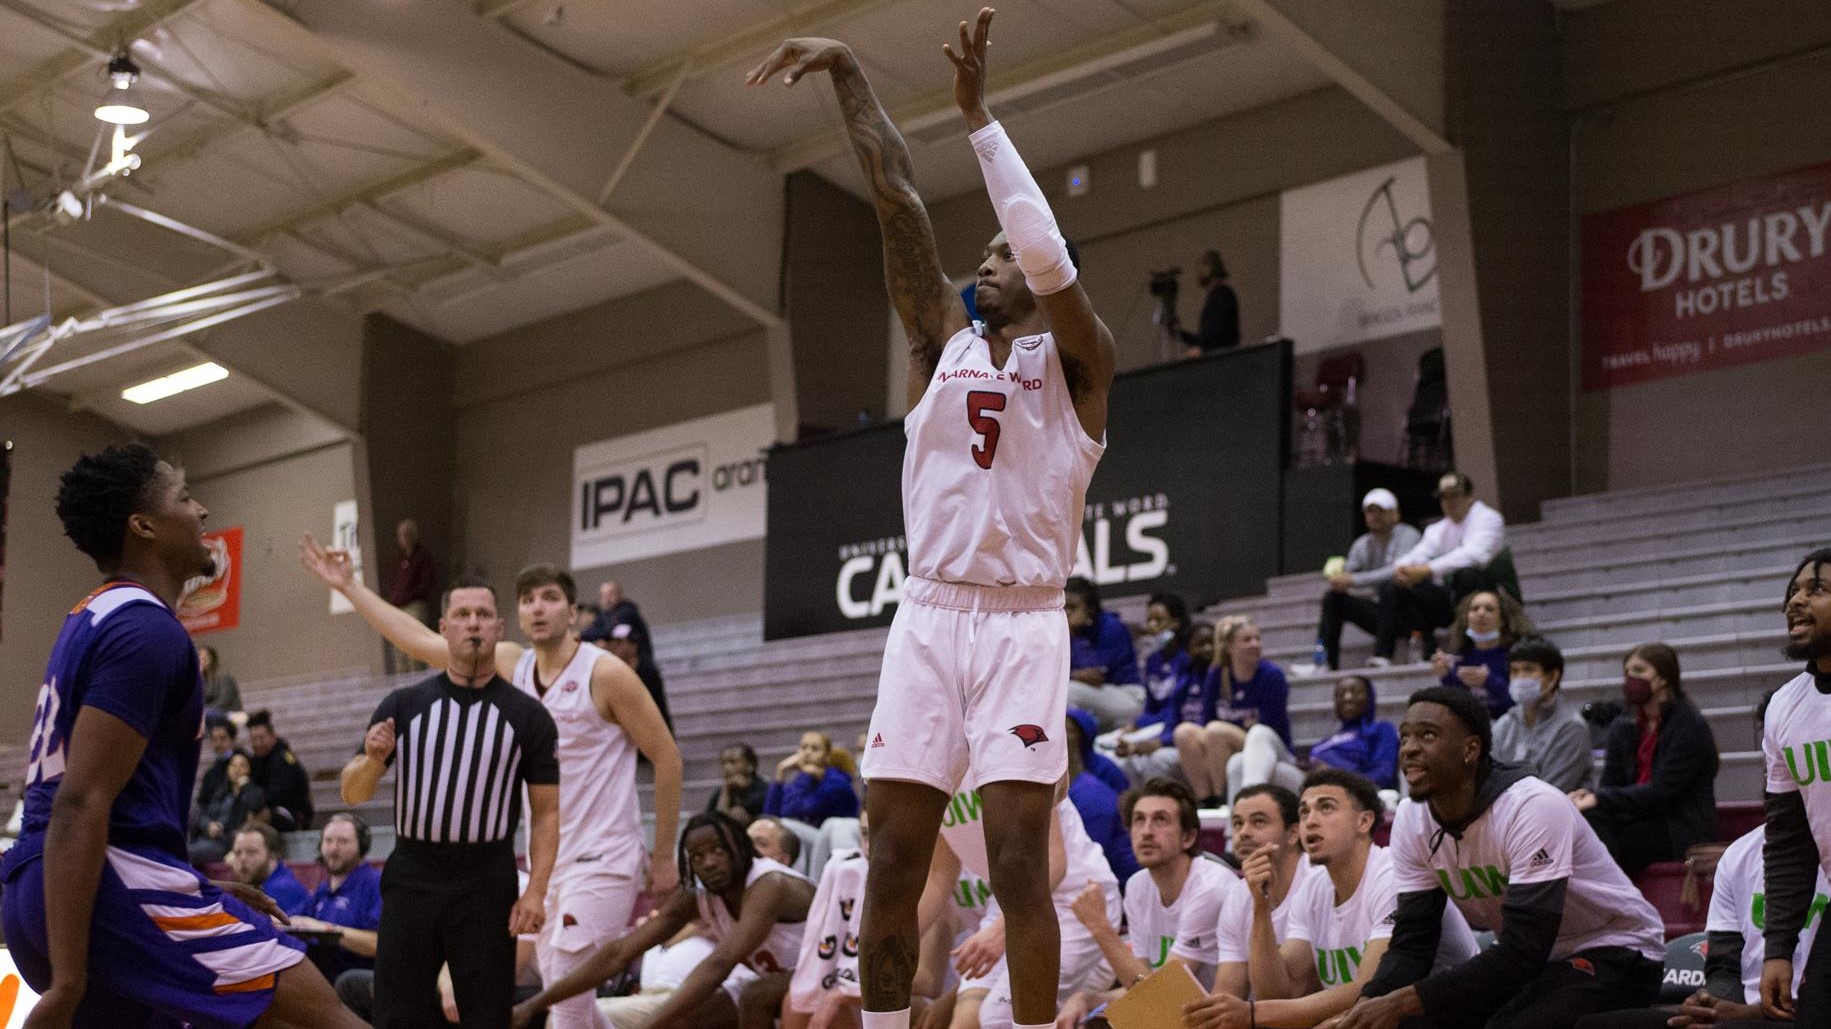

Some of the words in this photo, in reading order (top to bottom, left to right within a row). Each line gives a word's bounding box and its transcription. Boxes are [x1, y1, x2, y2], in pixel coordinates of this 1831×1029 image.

[1627, 200, 1831, 293] DRURY
[1676, 272, 1789, 319] HOTELS
[1009, 371, 1042, 391] WRD
[967, 390, 1007, 470] 5
[582, 458, 700, 531] IPAC
[1782, 740, 1831, 786] UI
[1663, 968, 1706, 986] ARD
